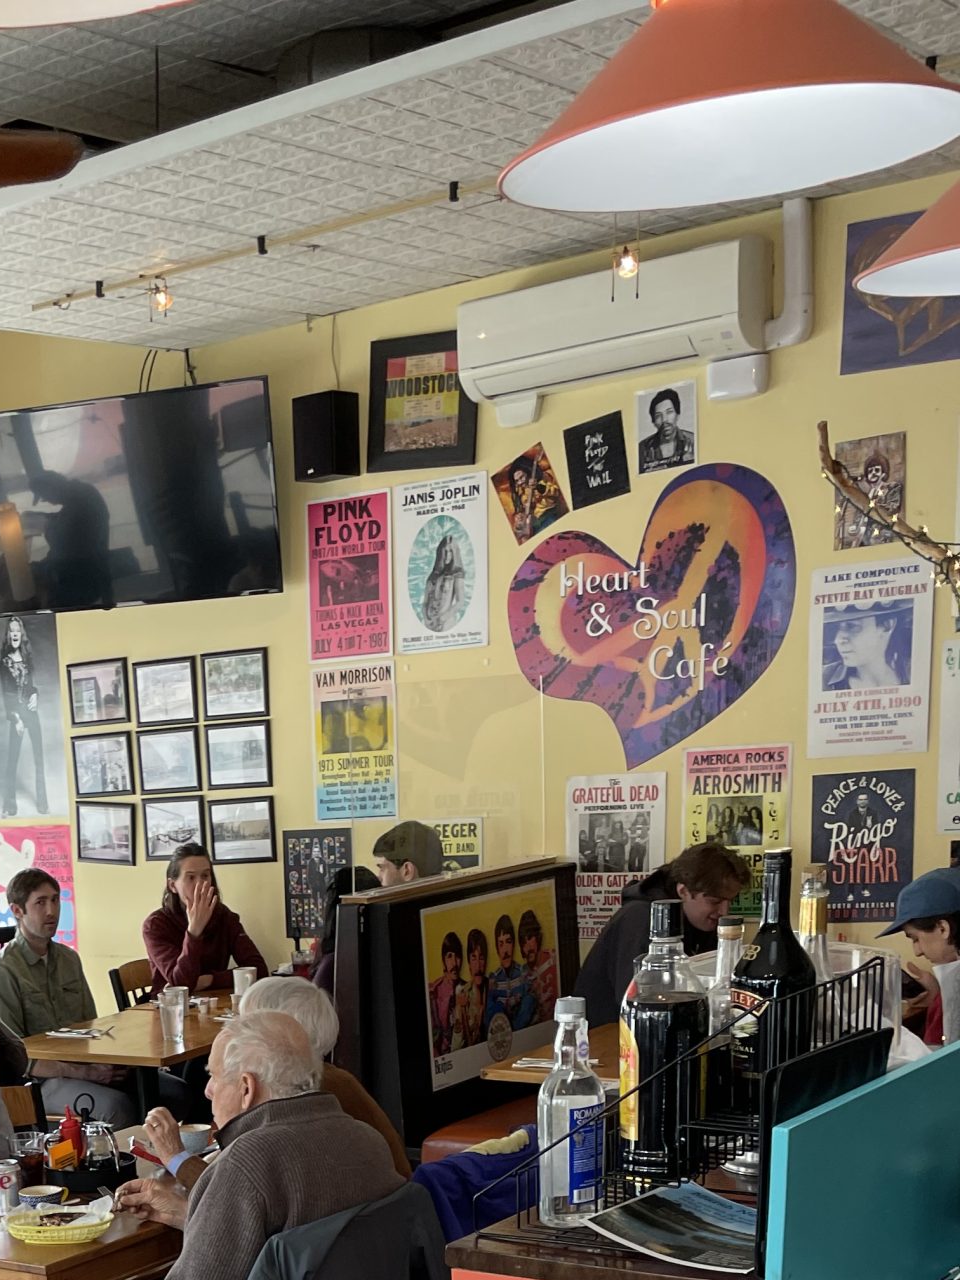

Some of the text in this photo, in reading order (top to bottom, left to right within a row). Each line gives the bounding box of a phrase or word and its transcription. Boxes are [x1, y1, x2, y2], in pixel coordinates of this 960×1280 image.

[584, 432, 604, 447] PINK
[586, 470, 612, 488] WALL
[402, 491, 435, 507] JANIS
[439, 484, 480, 501] JOPLIN
[323, 498, 372, 524] PINK
[416, 508, 438, 516] MARCH
[315, 520, 381, 547] FLOYD
[342, 543, 364, 555] WORLD
[368, 540, 385, 552] TOUR
[560, 561, 650, 597] Heart
[824, 564, 920, 583] LAKE COMPOUNCE
[814, 583, 928, 605] STEVIE RAY VAUGHAN
[321, 617, 379, 631] LAS VEGAS
[586, 593, 706, 640] & Soul
[649, 641, 732, 691] Café
[316, 666, 391, 688] VAN MORRISON
[814, 701, 848, 714] JULY
[888, 696, 922, 709] 1990
[319, 755, 394, 772] 1973 SUMMER TOUR
[692, 751, 785, 766] AMERICA ROCKS
[692, 772, 782, 795] AEROSMITH
[572, 785, 659, 804] GRATEFUL DEAD
[821, 776, 906, 815] PEACE & LOVE &
[457, 843, 475, 853] BAND
[824, 817, 897, 863] Ringo
[287, 836, 346, 866] PEACE
[832, 847, 899, 885] STARR
[576, 875, 603, 887] OLDEN
[607, 875, 628, 887] GATE
[576, 896, 595, 906] UN.
[827, 909, 859, 919] TOUR
